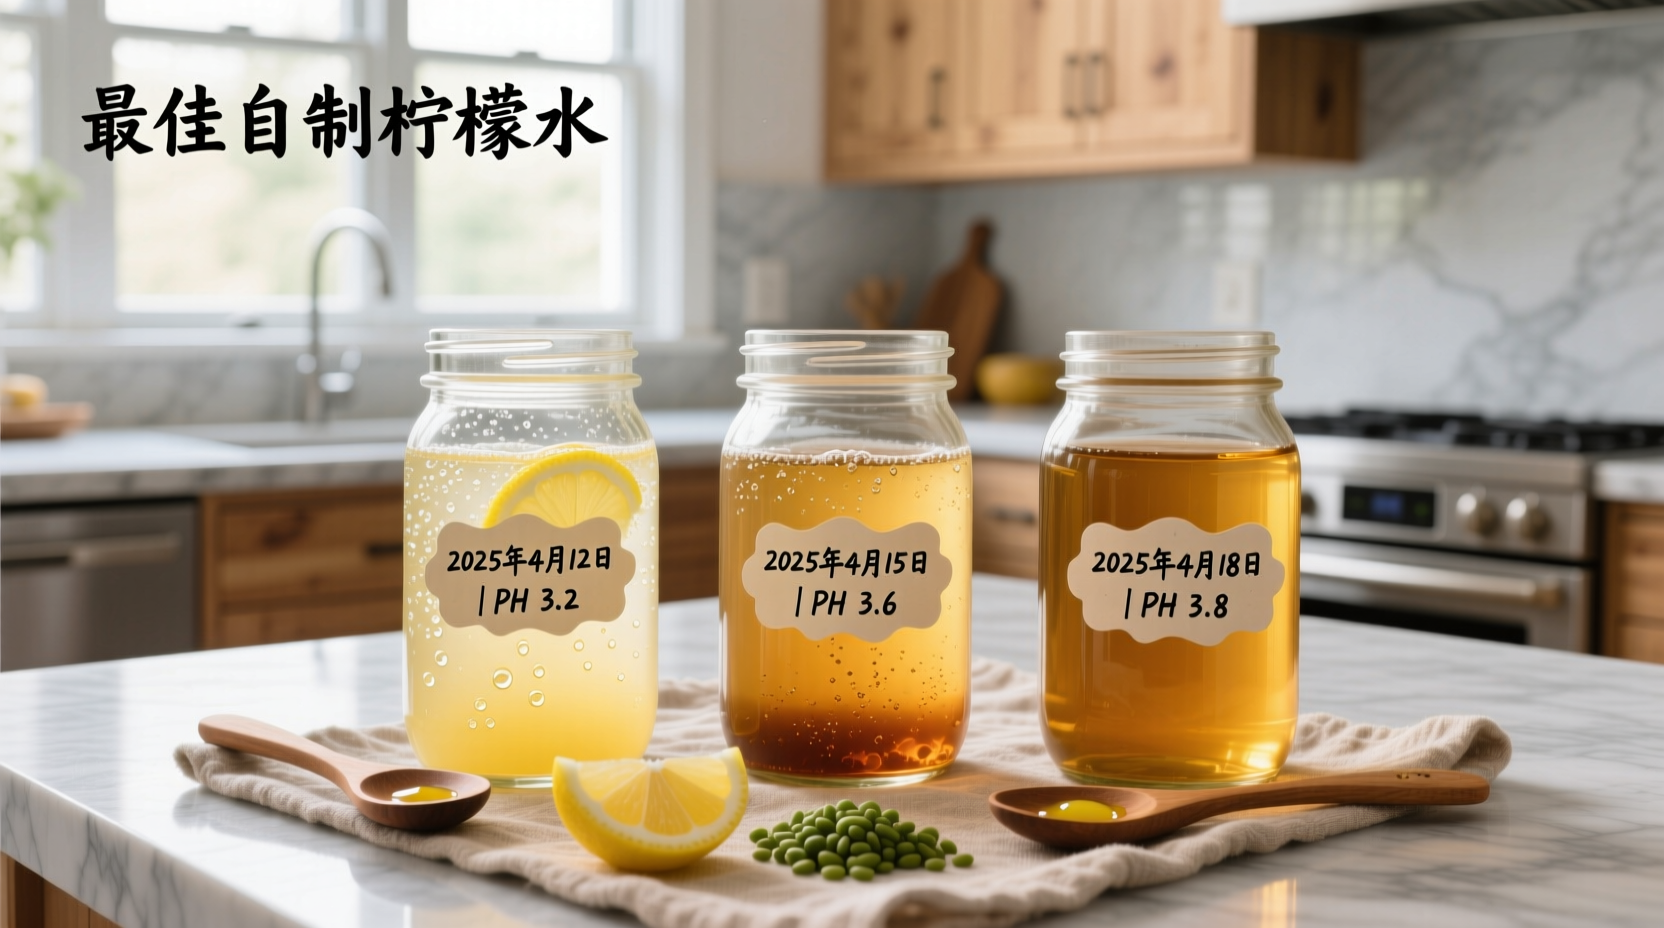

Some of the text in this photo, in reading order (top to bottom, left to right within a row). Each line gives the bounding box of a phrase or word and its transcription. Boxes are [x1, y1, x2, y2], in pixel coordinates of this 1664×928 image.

[447, 545, 610, 576] 2025年4月12日
[764, 547, 926, 578] 2025年4月15日
[1092, 548, 1260, 581] 2025年4月18日
[494, 588, 528, 614] PH
[541, 588, 579, 611] 3.2
[812, 590, 846, 615] PH
[859, 591, 896, 615] 3.6
[1141, 592, 1177, 618] PH
[1189, 594, 1228, 618] 3.8
